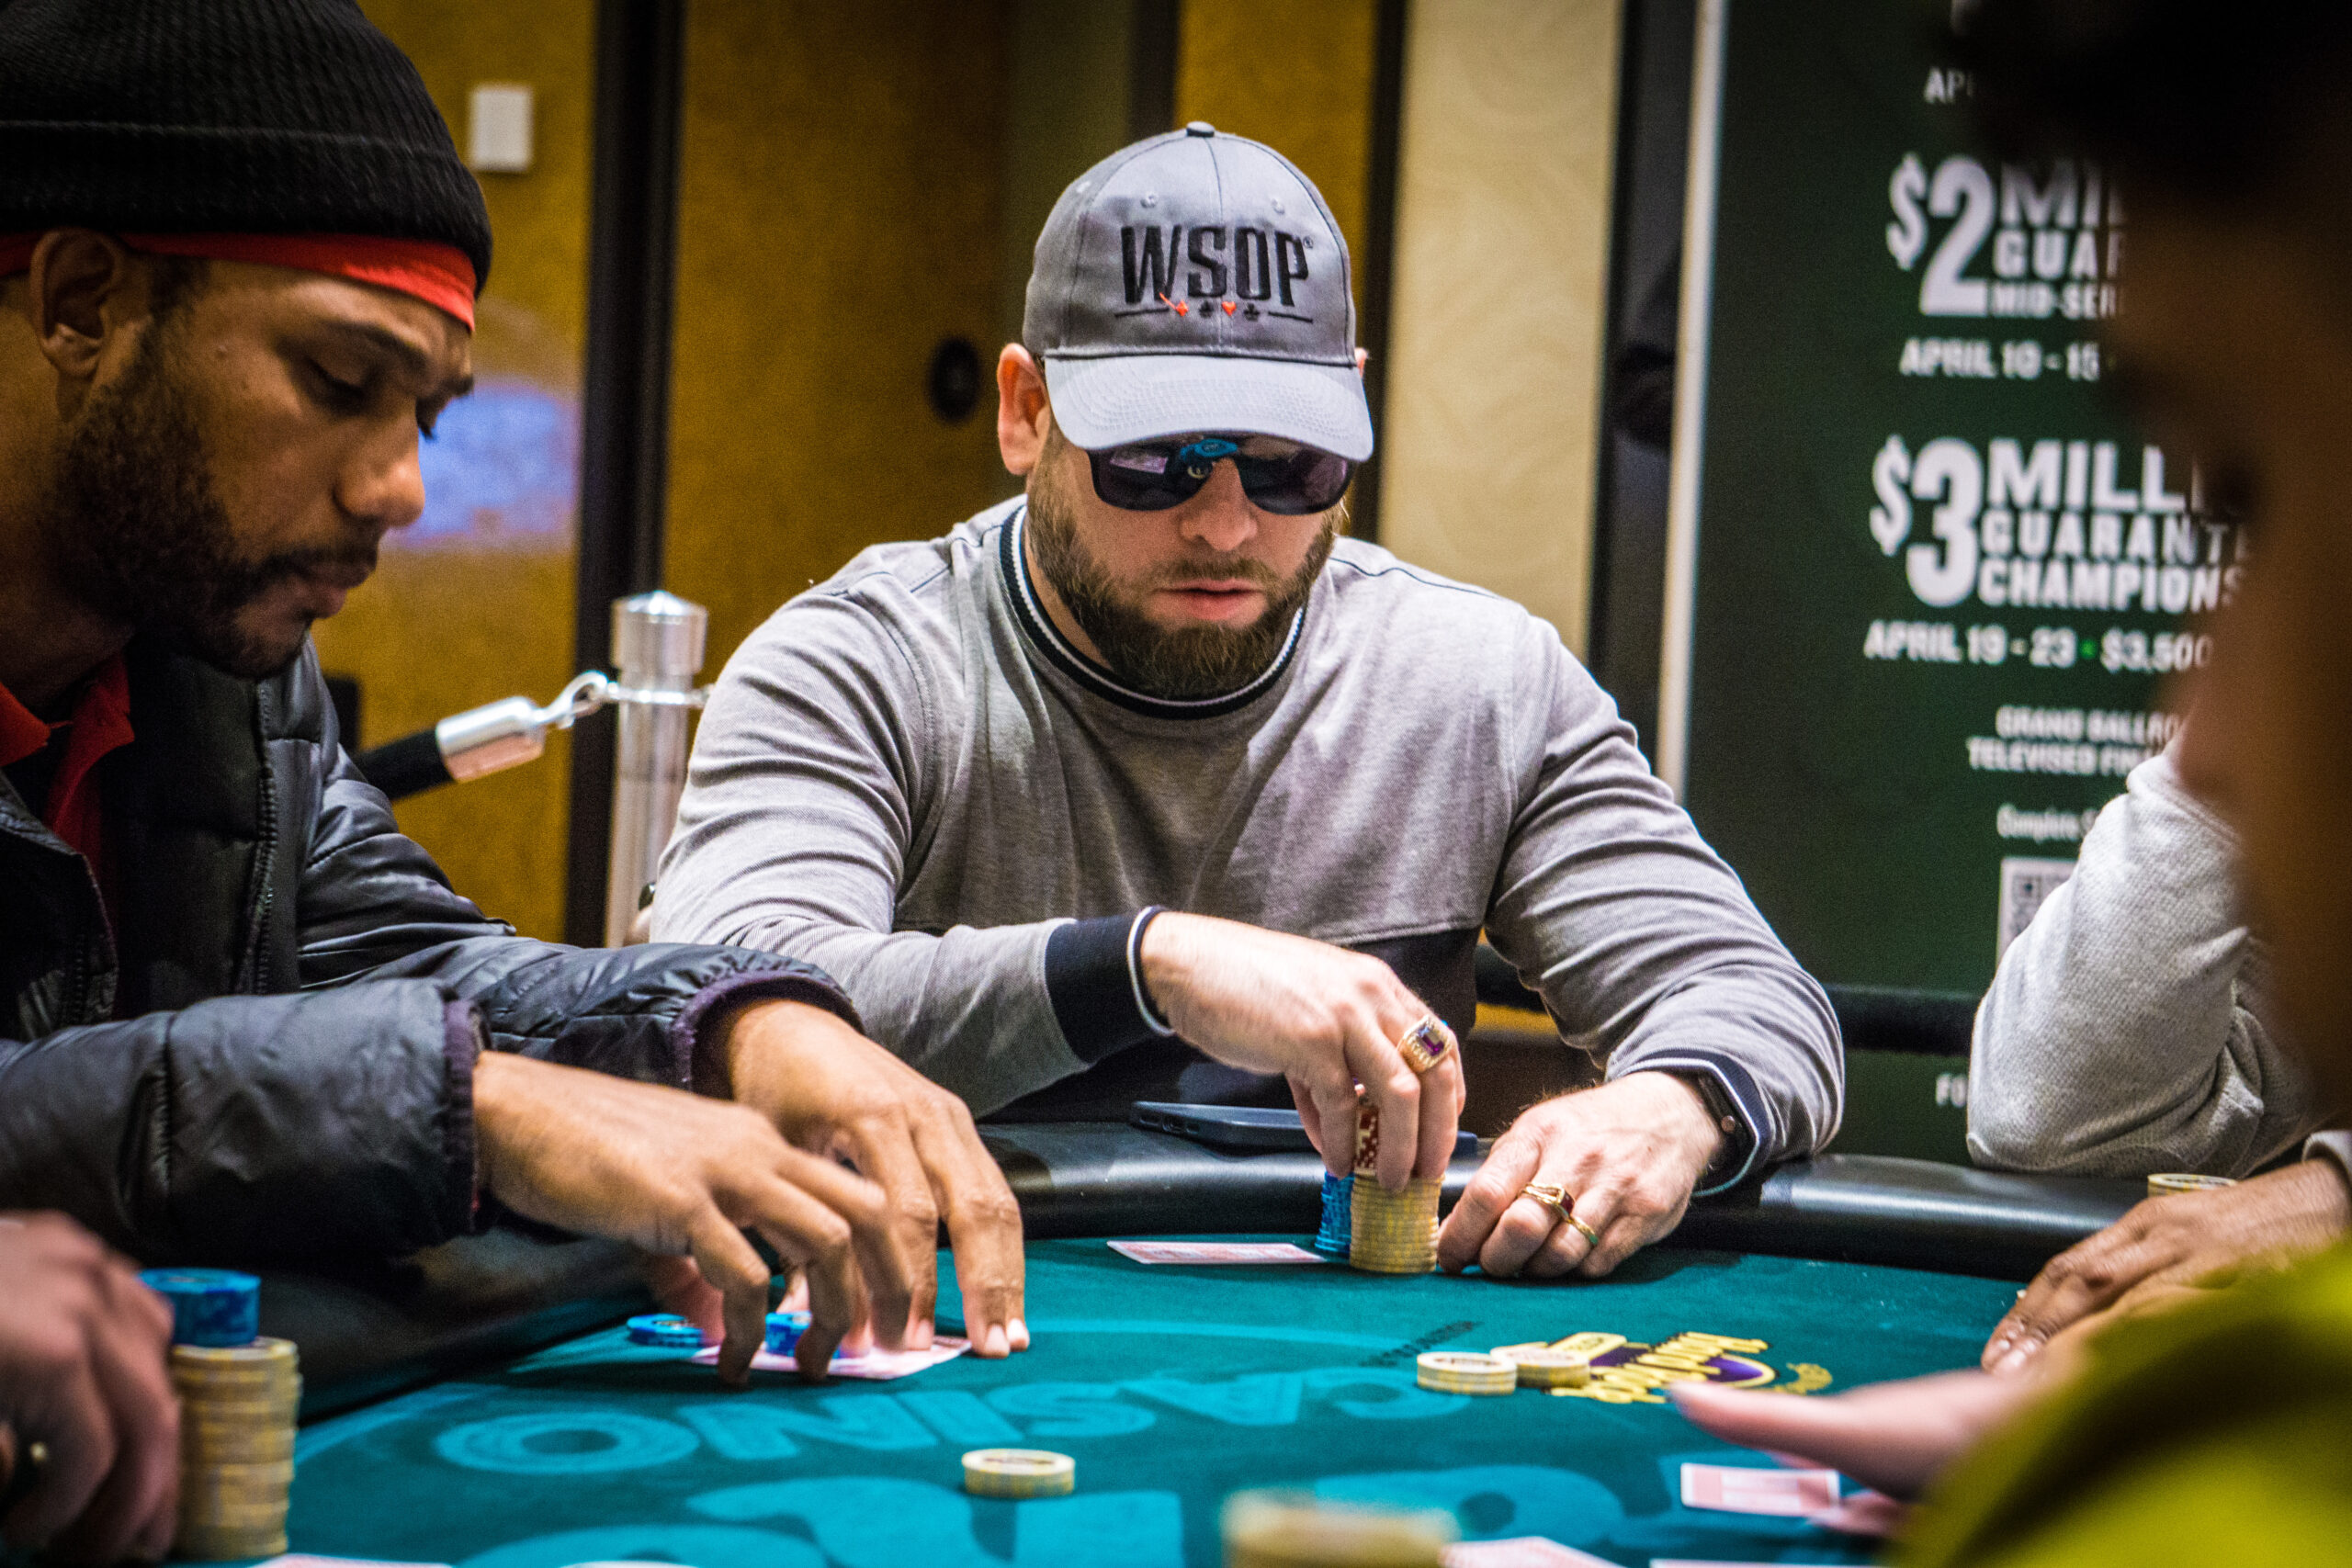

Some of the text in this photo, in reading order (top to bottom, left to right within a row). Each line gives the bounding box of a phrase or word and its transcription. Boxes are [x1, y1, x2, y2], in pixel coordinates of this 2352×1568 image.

[1925, 67, 1975, 104] AP
[1886, 152, 1996, 318] $2
[1120, 224, 1309, 307] WSOP
[1899, 337, 1996, 378] APRIL
[2002, 340, 2041, 380] 10
[1869, 434, 1983, 607] $3
[1977, 559, 2245, 614] CHAMPIONS
[1863, 620, 1962, 663] APRIL
[1966, 624, 2007, 665] 19
[2030, 626, 2077, 668] 23
[1996, 705, 2181, 748] GRAND BALLRO
[1967, 735, 2098, 775] TELEVISED
[1936, 1072, 1969, 1107] FO
[433, 1366, 1470, 1475] CASINO
